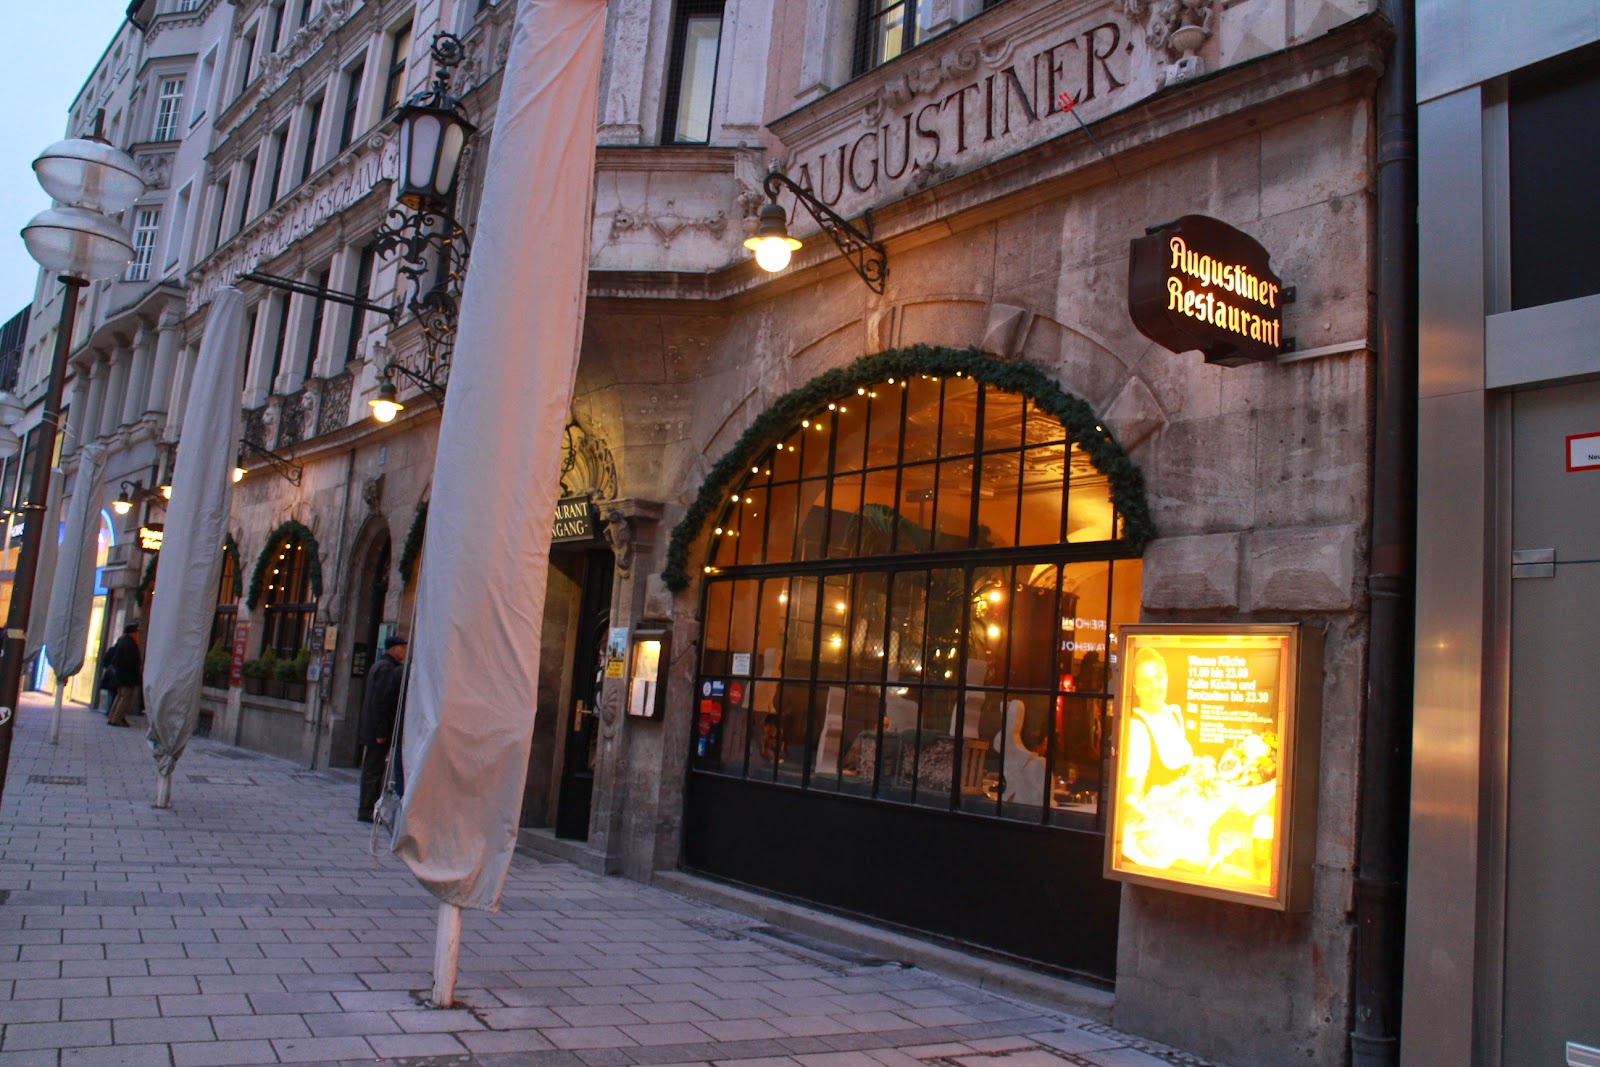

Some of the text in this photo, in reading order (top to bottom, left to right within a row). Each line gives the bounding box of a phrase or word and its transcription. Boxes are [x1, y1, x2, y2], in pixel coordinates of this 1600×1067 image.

[787, 21, 1126, 225] AUGUSTINER
[1169, 236, 1279, 309] Augustiner
[1167, 276, 1280, 348] Restaurant
[1188, 655, 1246, 667] Warme Küche
[1211, 667, 1224, 678] bis
[1187, 678, 1256, 691] Kalte Küche und
[1230, 691, 1244, 703] bis
[1245, 692, 1269, 703] 23.30
